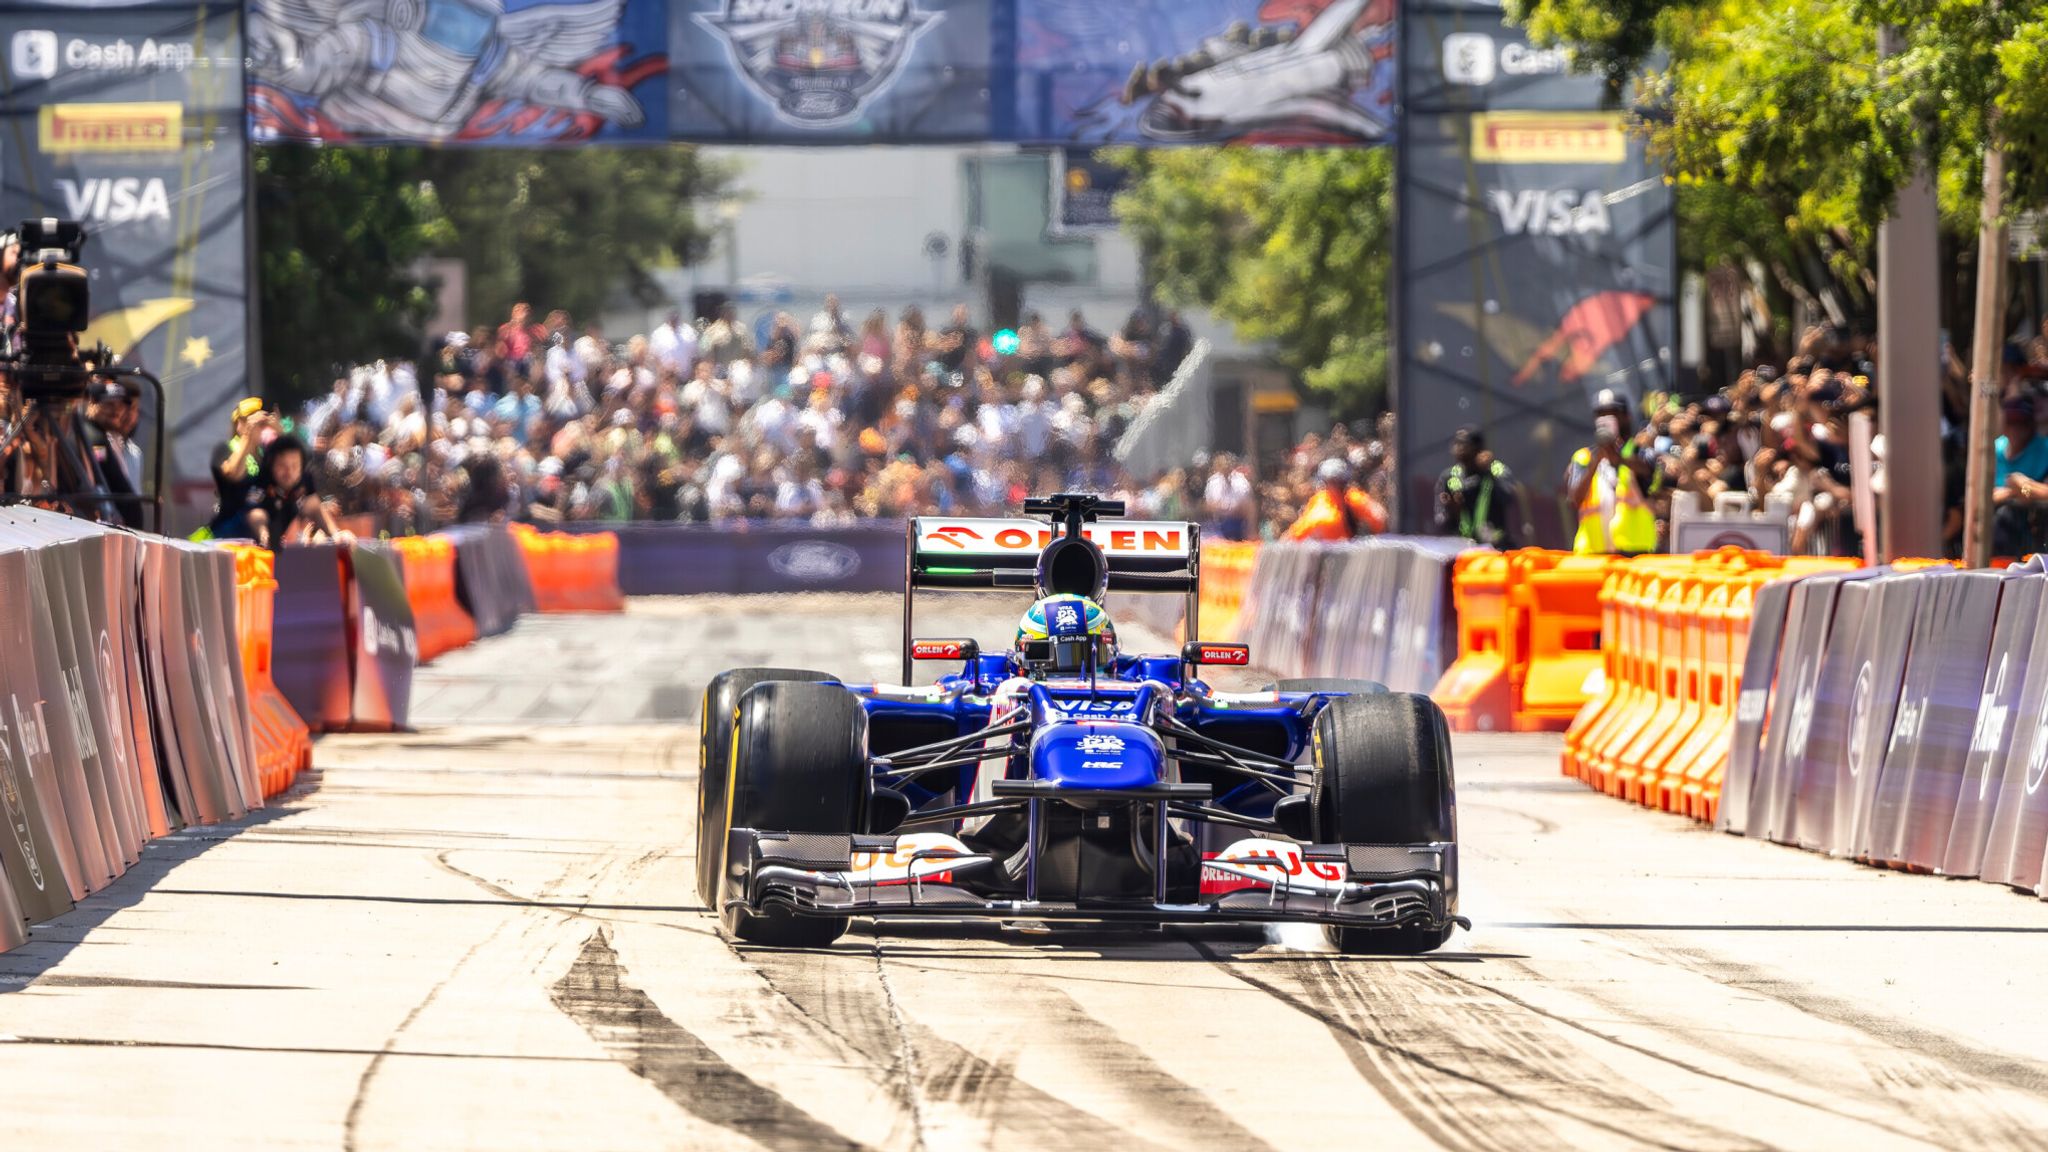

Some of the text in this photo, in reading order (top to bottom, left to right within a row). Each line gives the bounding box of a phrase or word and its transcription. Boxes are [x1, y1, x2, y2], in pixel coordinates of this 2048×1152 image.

[66, 38, 194, 70] Cash App
[54, 177, 170, 220] VISA
[1488, 188, 1611, 234] VISA
[994, 528, 1180, 550] OEN
[915, 646, 943, 654] ORLEN
[1204, 651, 1231, 659] ORLEN
[1053, 700, 1135, 712] VISA
[851, 844, 962, 872] UGO
[1202, 866, 1242, 881] ORLEN
